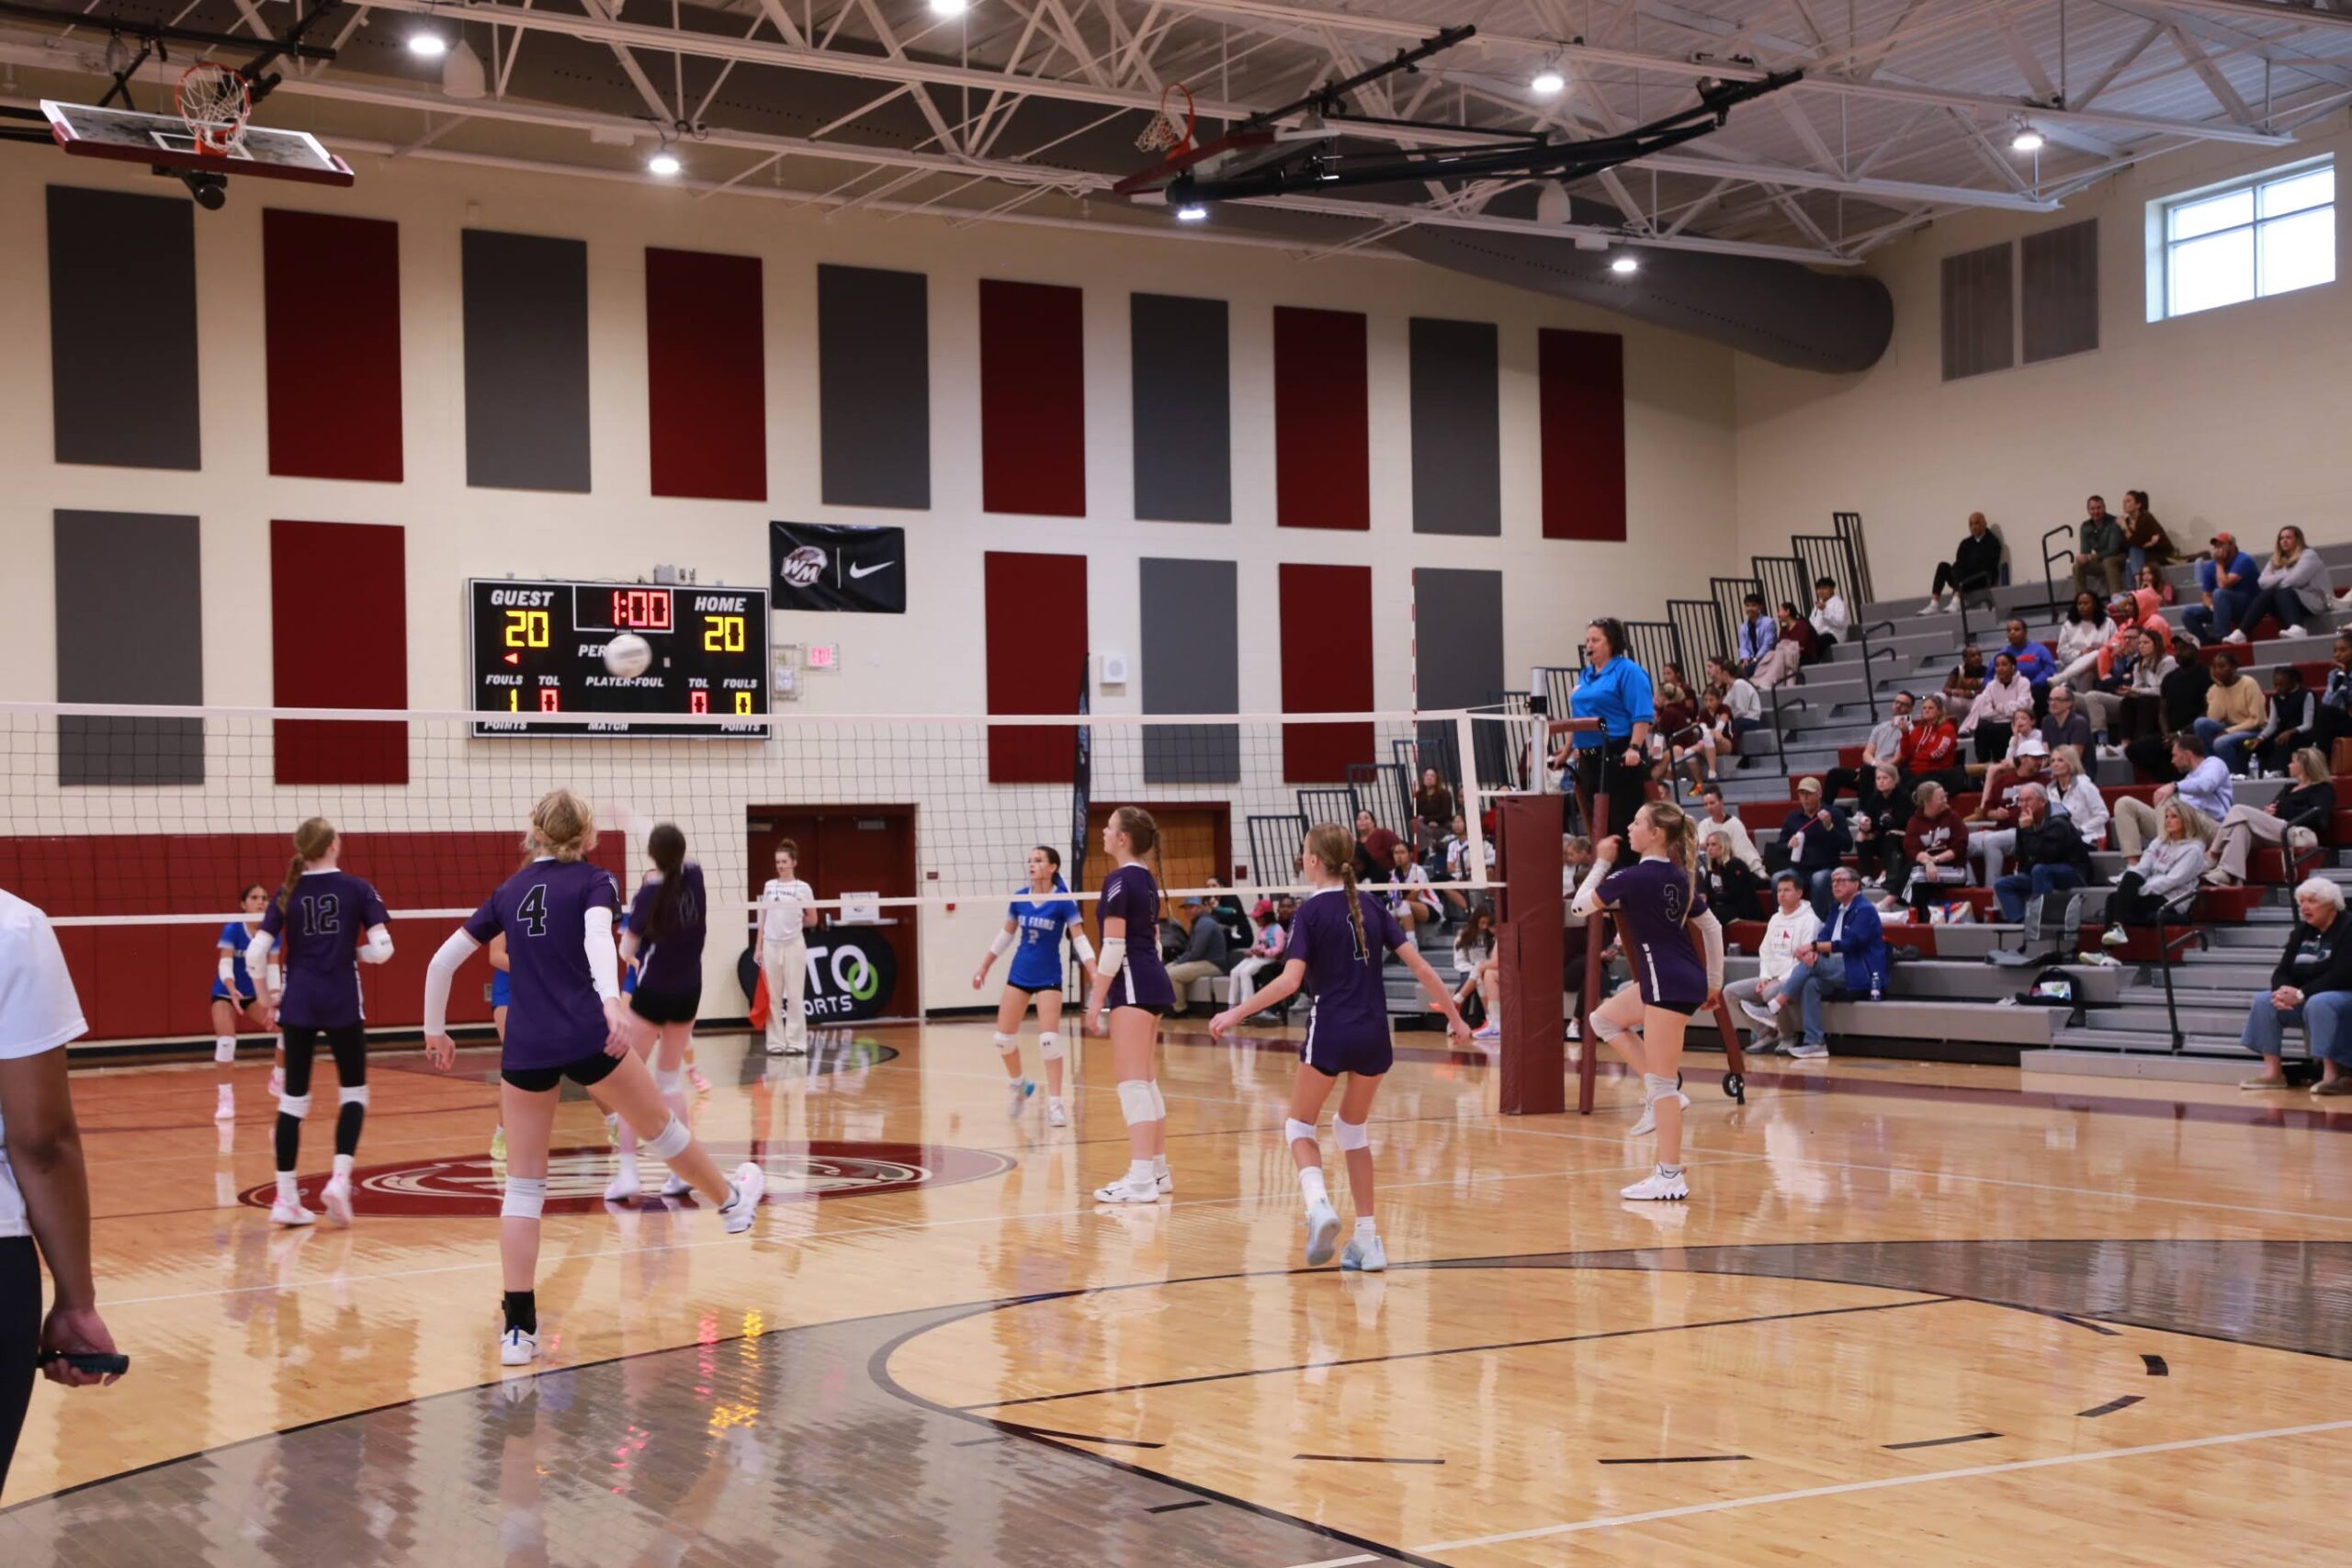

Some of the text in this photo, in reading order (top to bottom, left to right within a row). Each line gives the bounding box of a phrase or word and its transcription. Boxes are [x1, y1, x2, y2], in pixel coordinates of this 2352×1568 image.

[784, 559, 819, 582] WM
[491, 590, 554, 606] GUEST
[695, 596, 747, 612] HOME
[613, 591, 669, 626] 1:00
[505, 610, 549, 648] 20
[704, 615, 744, 652] 20
[578, 644, 606, 658] PER
[485, 674, 524, 685] FOULS
[538, 675, 560, 686] TOL
[585, 675, 664, 688] PLAYER-FOUL
[688, 678, 709, 688] TOL
[723, 678, 758, 689] FOULS
[517, 884, 547, 937] 4
[1664, 884, 1679, 922] 3
[301, 893, 339, 936] 12
